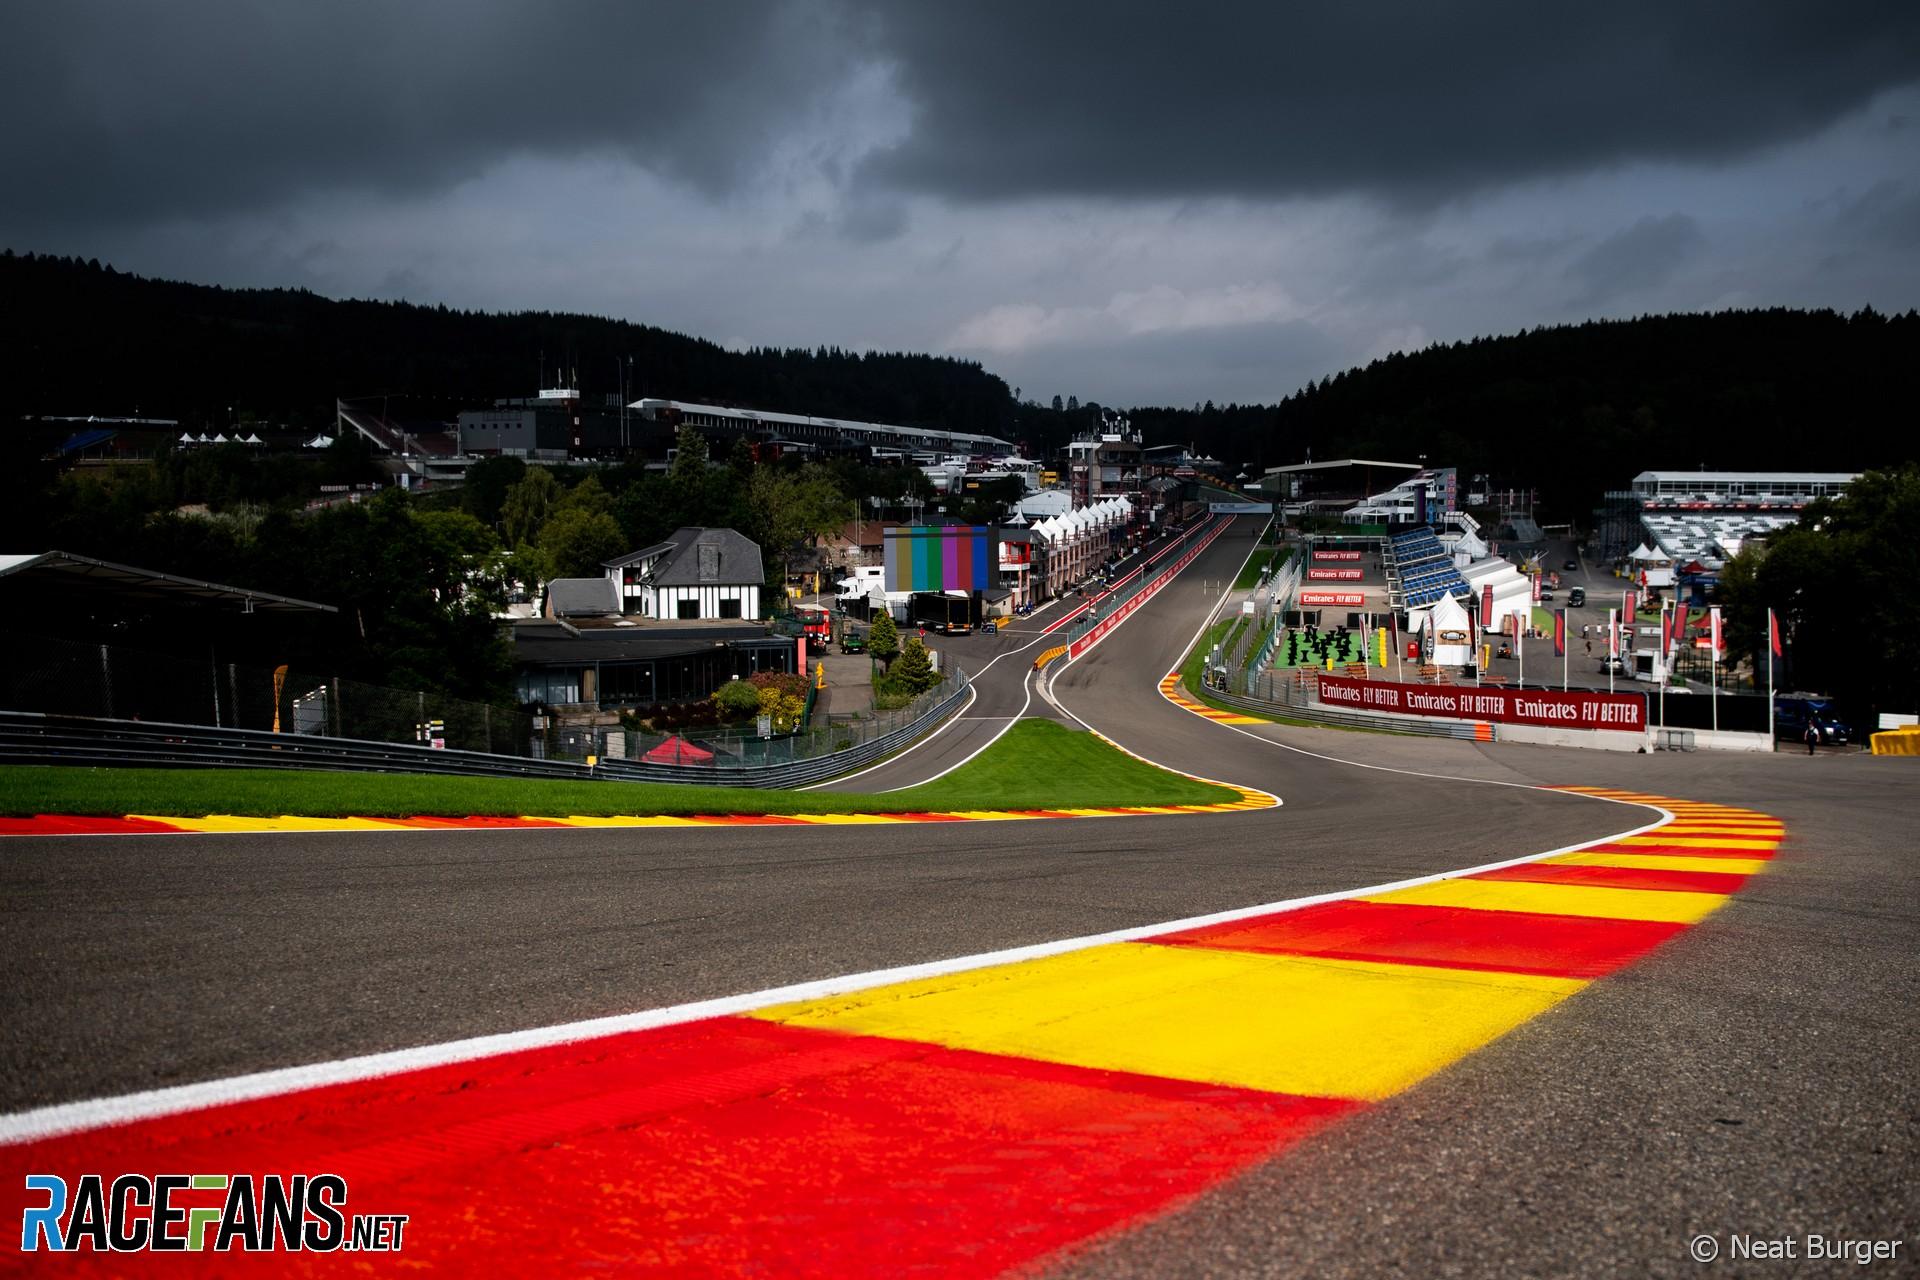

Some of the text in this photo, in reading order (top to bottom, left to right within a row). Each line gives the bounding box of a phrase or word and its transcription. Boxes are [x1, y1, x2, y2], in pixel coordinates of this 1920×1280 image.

[1303, 594, 1335, 603] Emirates
[1321, 681, 1399, 706] Emirates FLY BETTER
[1406, 690, 1505, 715] Emirates FLY BETTER
[1515, 697, 1638, 724] Emirates FLY BETTER
